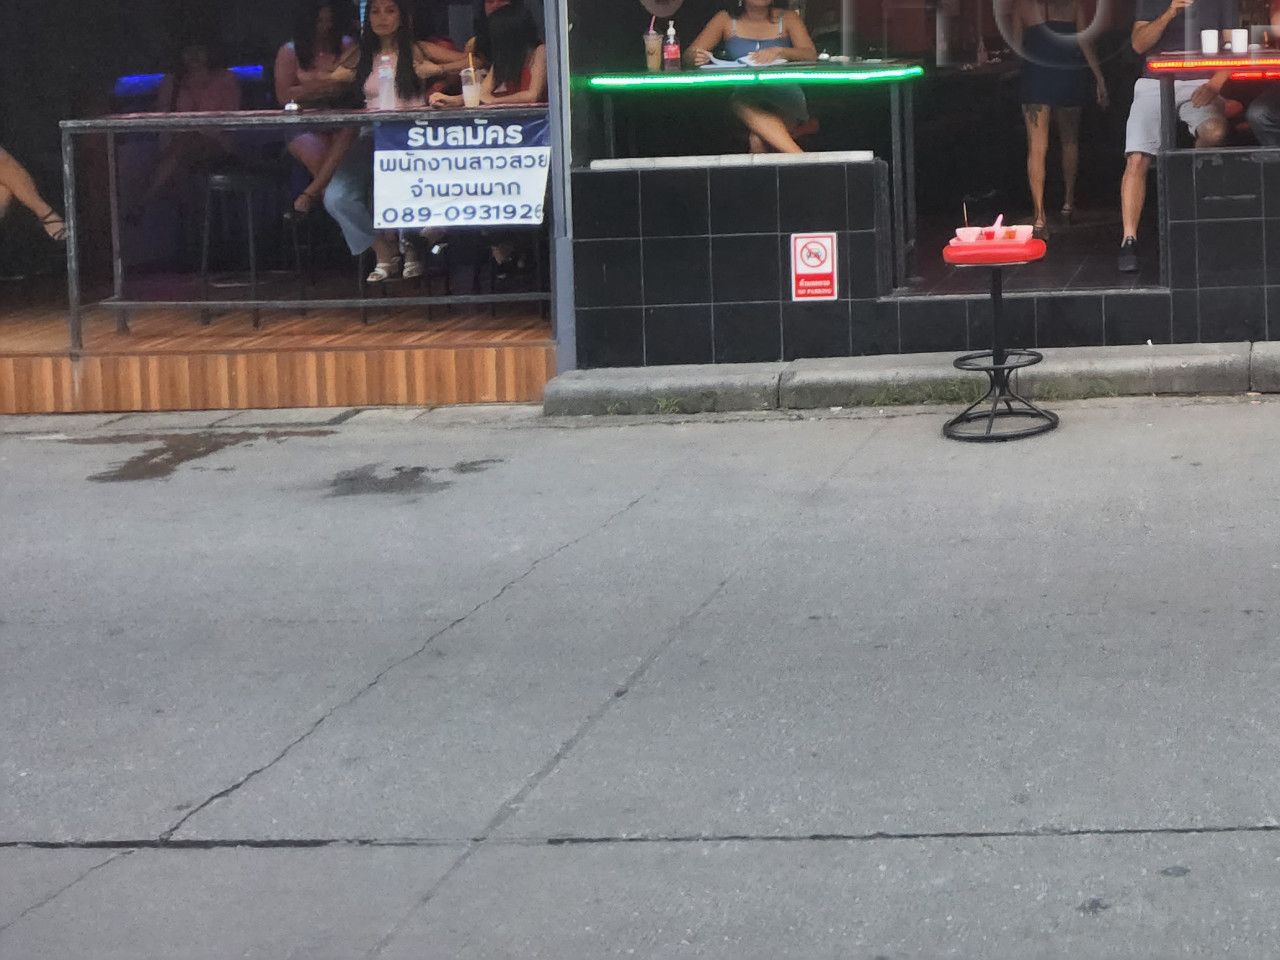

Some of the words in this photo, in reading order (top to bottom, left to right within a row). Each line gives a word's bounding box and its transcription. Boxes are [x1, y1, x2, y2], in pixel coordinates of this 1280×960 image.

[407, 119, 523, 147] รับสมัคร
[410, 178, 521, 198] จำนวนมาก
